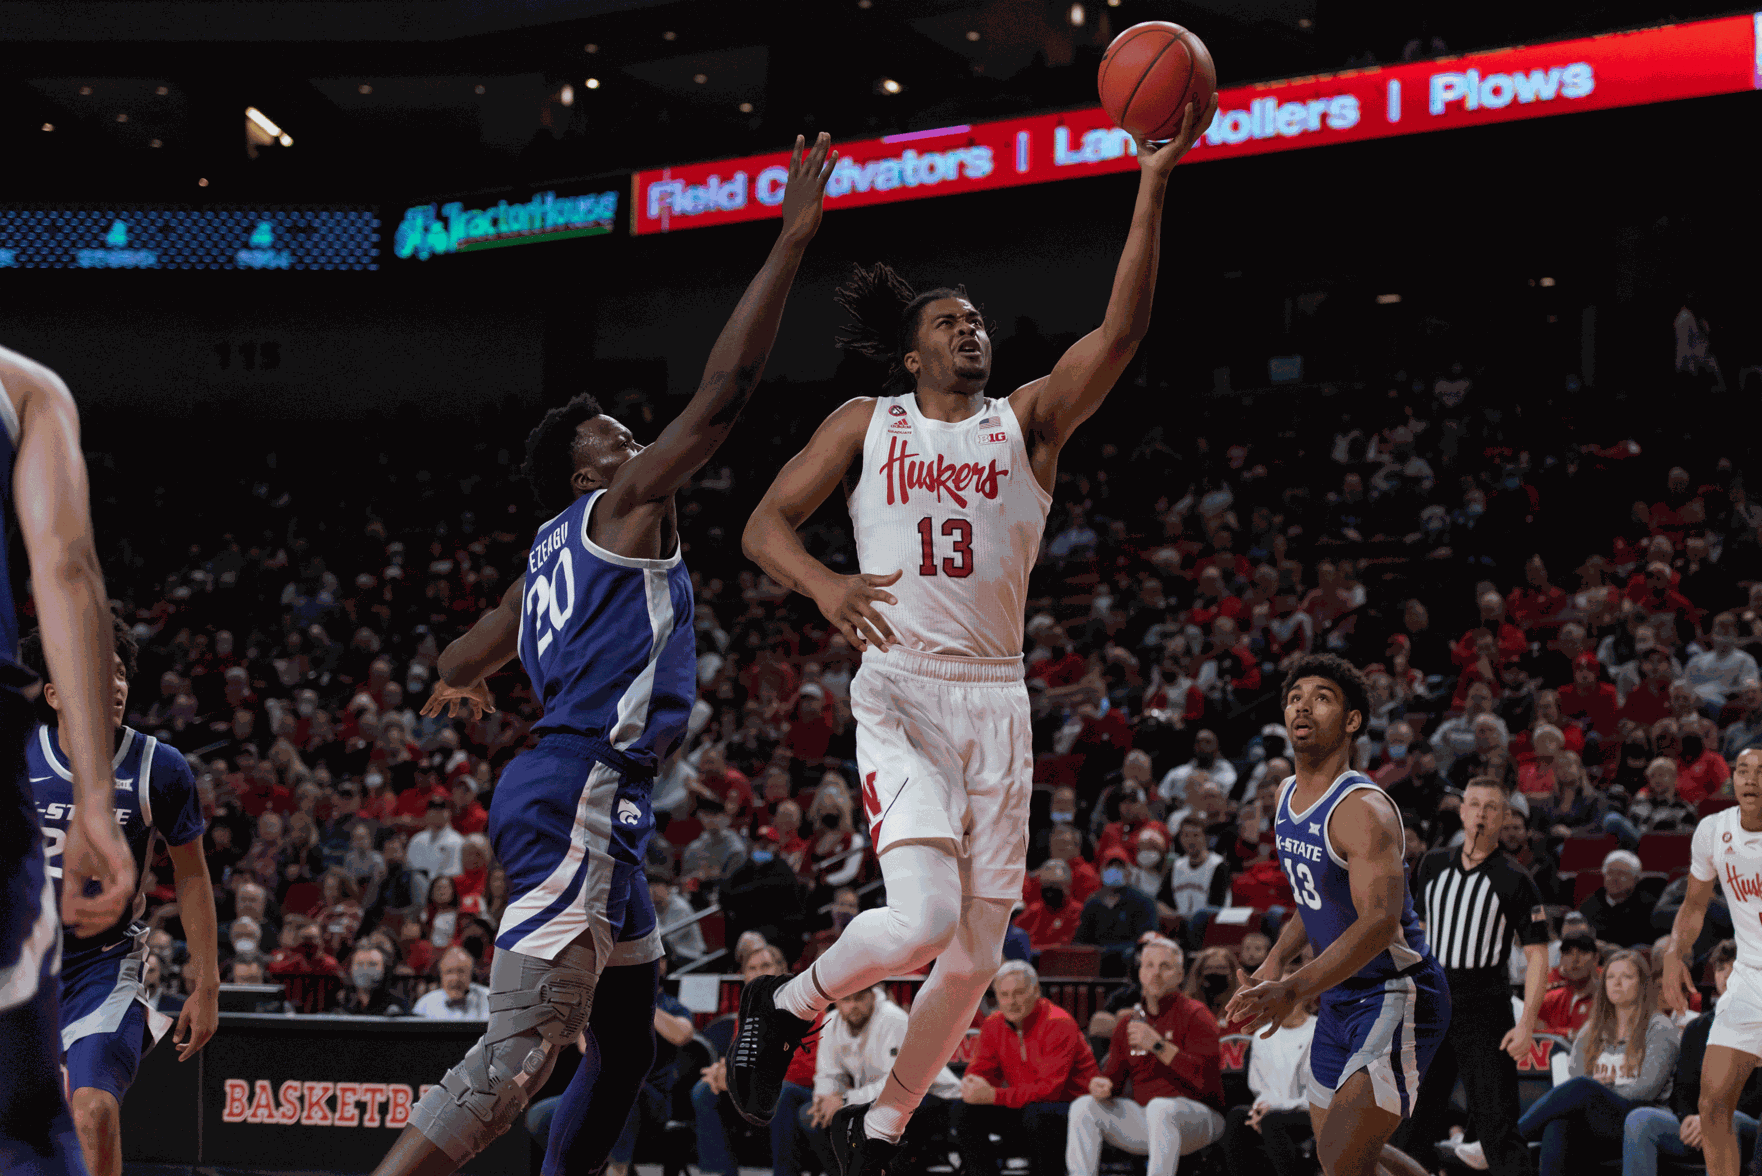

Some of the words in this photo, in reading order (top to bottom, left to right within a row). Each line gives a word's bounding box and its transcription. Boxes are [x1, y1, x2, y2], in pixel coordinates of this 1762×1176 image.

[646, 169, 749, 220] Field
[1054, 125, 1138, 166] Lan
[1429, 61, 1596, 116] Plows
[879, 436, 1009, 509] Huskers
[528, 521, 569, 575] EZEAGU
[917, 516, 974, 579] 13
[526, 546, 575, 661] 20
[1275, 833, 1323, 863] K-STATE
[1283, 857, 1323, 911] 13
[222, 1078, 432, 1129] BASKETB
